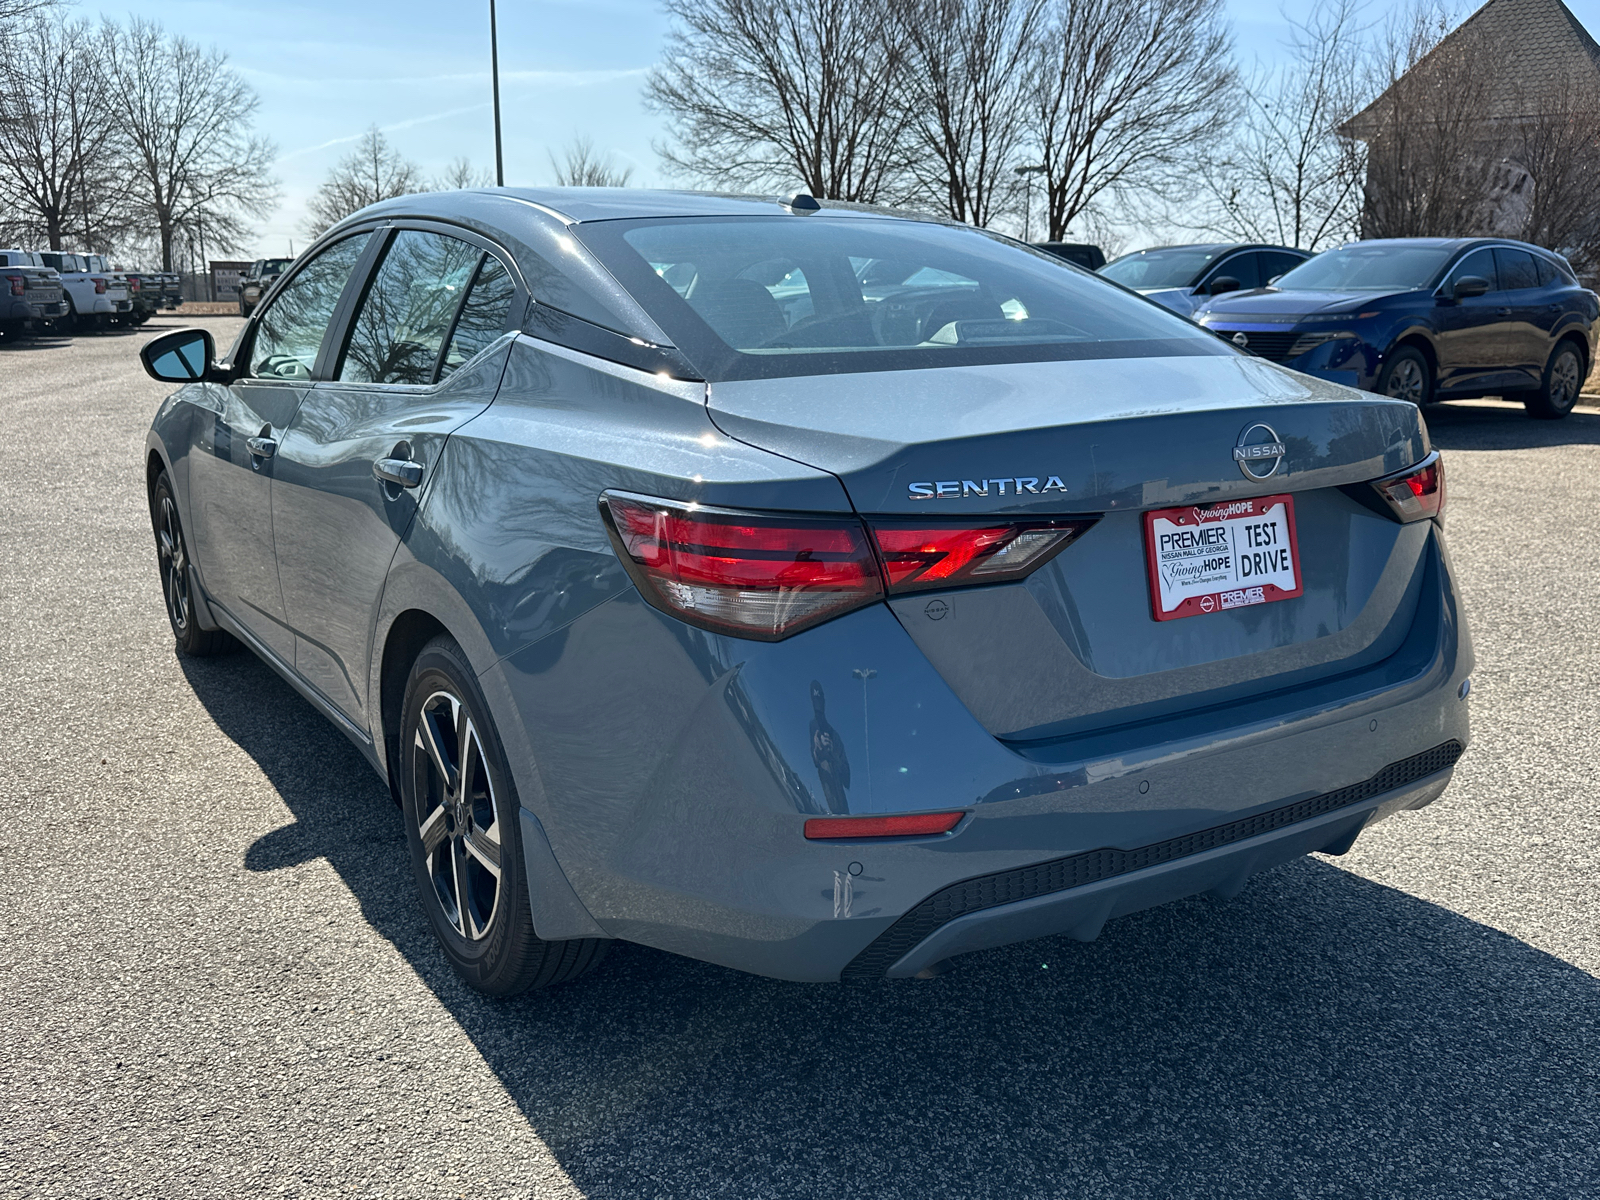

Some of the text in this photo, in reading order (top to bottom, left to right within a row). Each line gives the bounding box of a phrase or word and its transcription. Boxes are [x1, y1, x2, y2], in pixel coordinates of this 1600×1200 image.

[1235, 444, 1286, 459] NISSAN
[908, 475, 1068, 501] SENTRA
[1160, 526, 1228, 552] PREMIER
[1245, 522, 1278, 549] TEST
[1161, 551, 1183, 560] NISSAN
[1183, 549, 1197, 558] MALL
[1205, 545, 1229, 554] GEORGIA
[1241, 548, 1290, 578] DRIVE
[1220, 587, 1265, 604] PREMIER
